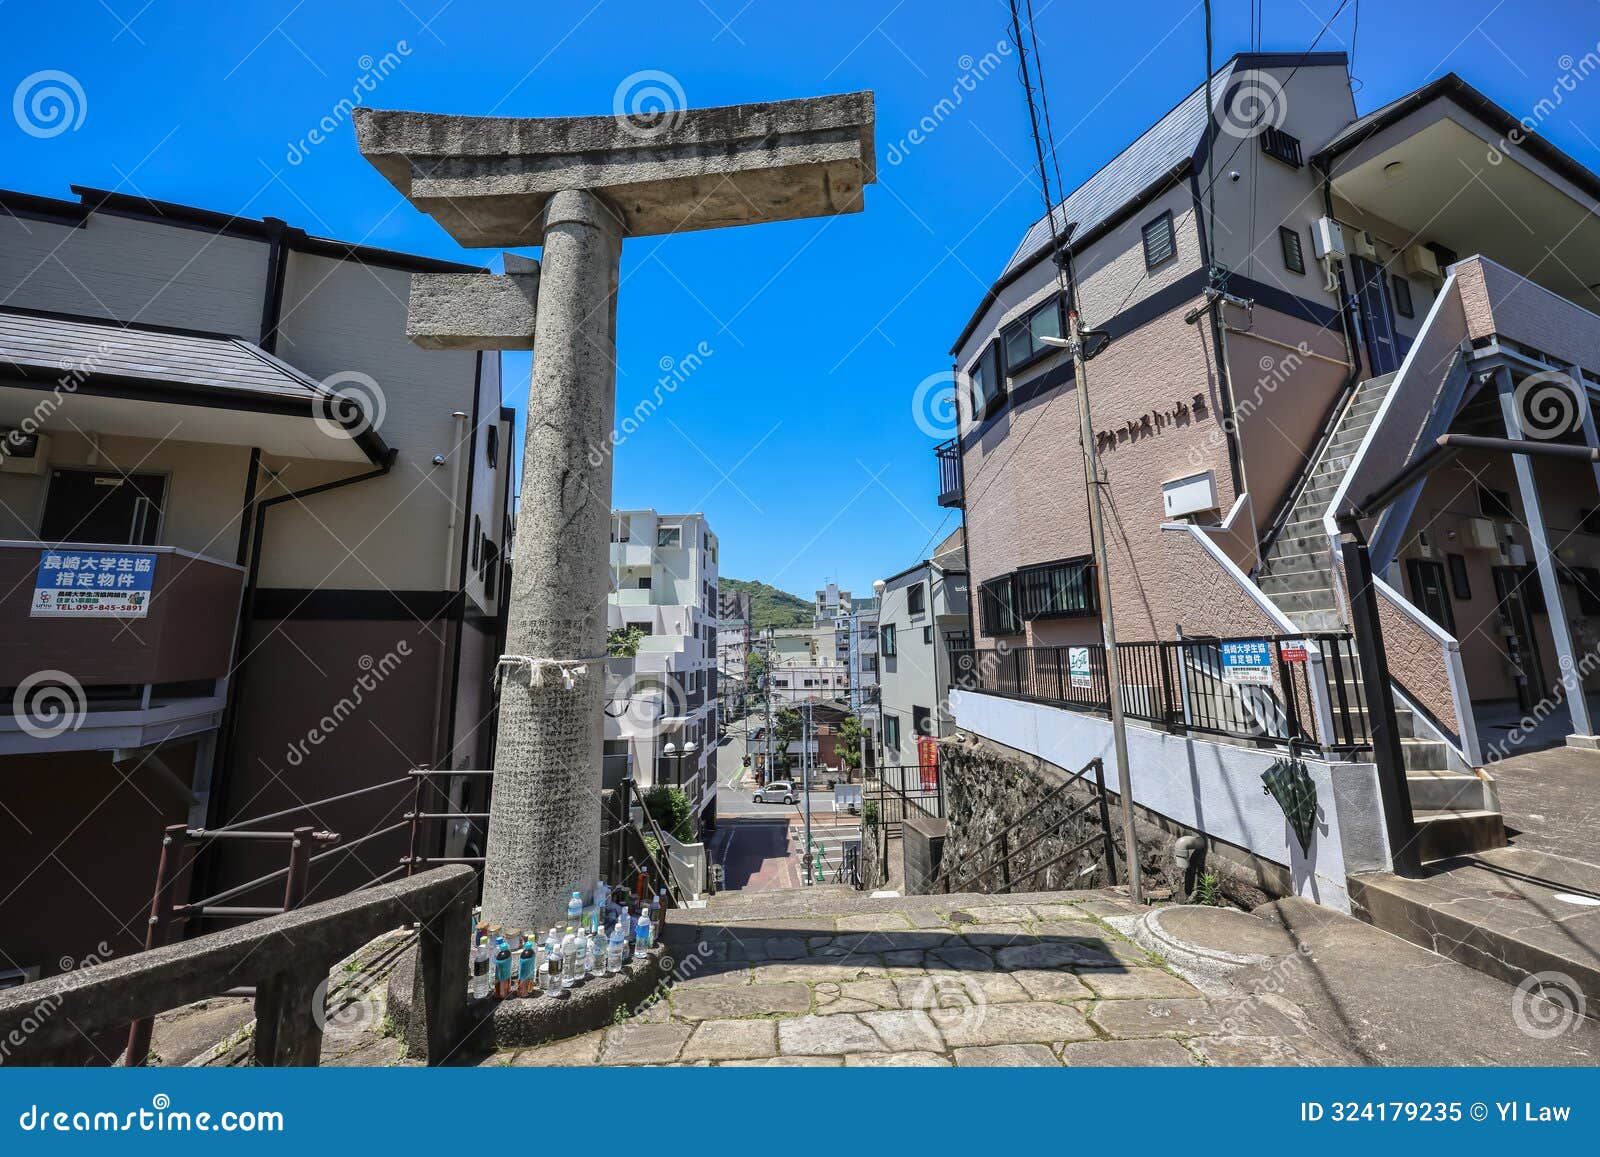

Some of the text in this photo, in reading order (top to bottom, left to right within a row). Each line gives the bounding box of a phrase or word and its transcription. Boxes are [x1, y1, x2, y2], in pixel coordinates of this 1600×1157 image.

[44, 555, 151, 572] 長崎大学生協
[55, 572, 135, 587] 指定物件
[1223, 643, 1266, 654] 長崎大学生協
[1230, 655, 1262, 665] 指定物件
